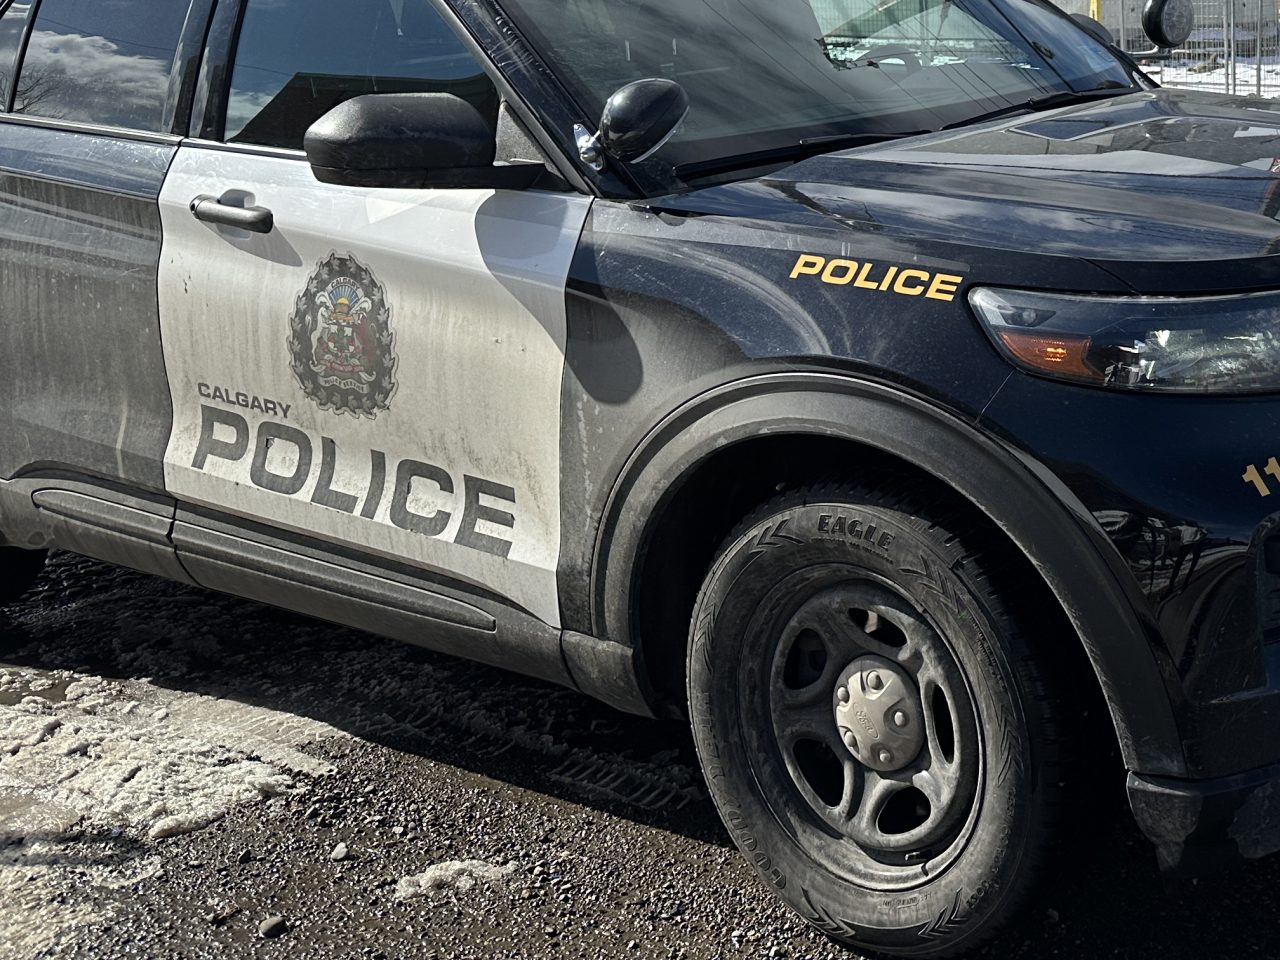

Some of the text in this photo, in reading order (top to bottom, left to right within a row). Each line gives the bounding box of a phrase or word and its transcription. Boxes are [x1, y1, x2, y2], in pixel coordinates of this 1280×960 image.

[330, 277, 361, 290] CALGARY
[789, 244, 963, 292] POLICE
[197, 381, 292, 419] CALGARY
[190, 404, 516, 559] POLICE
[818, 514, 896, 552] EAGLE
